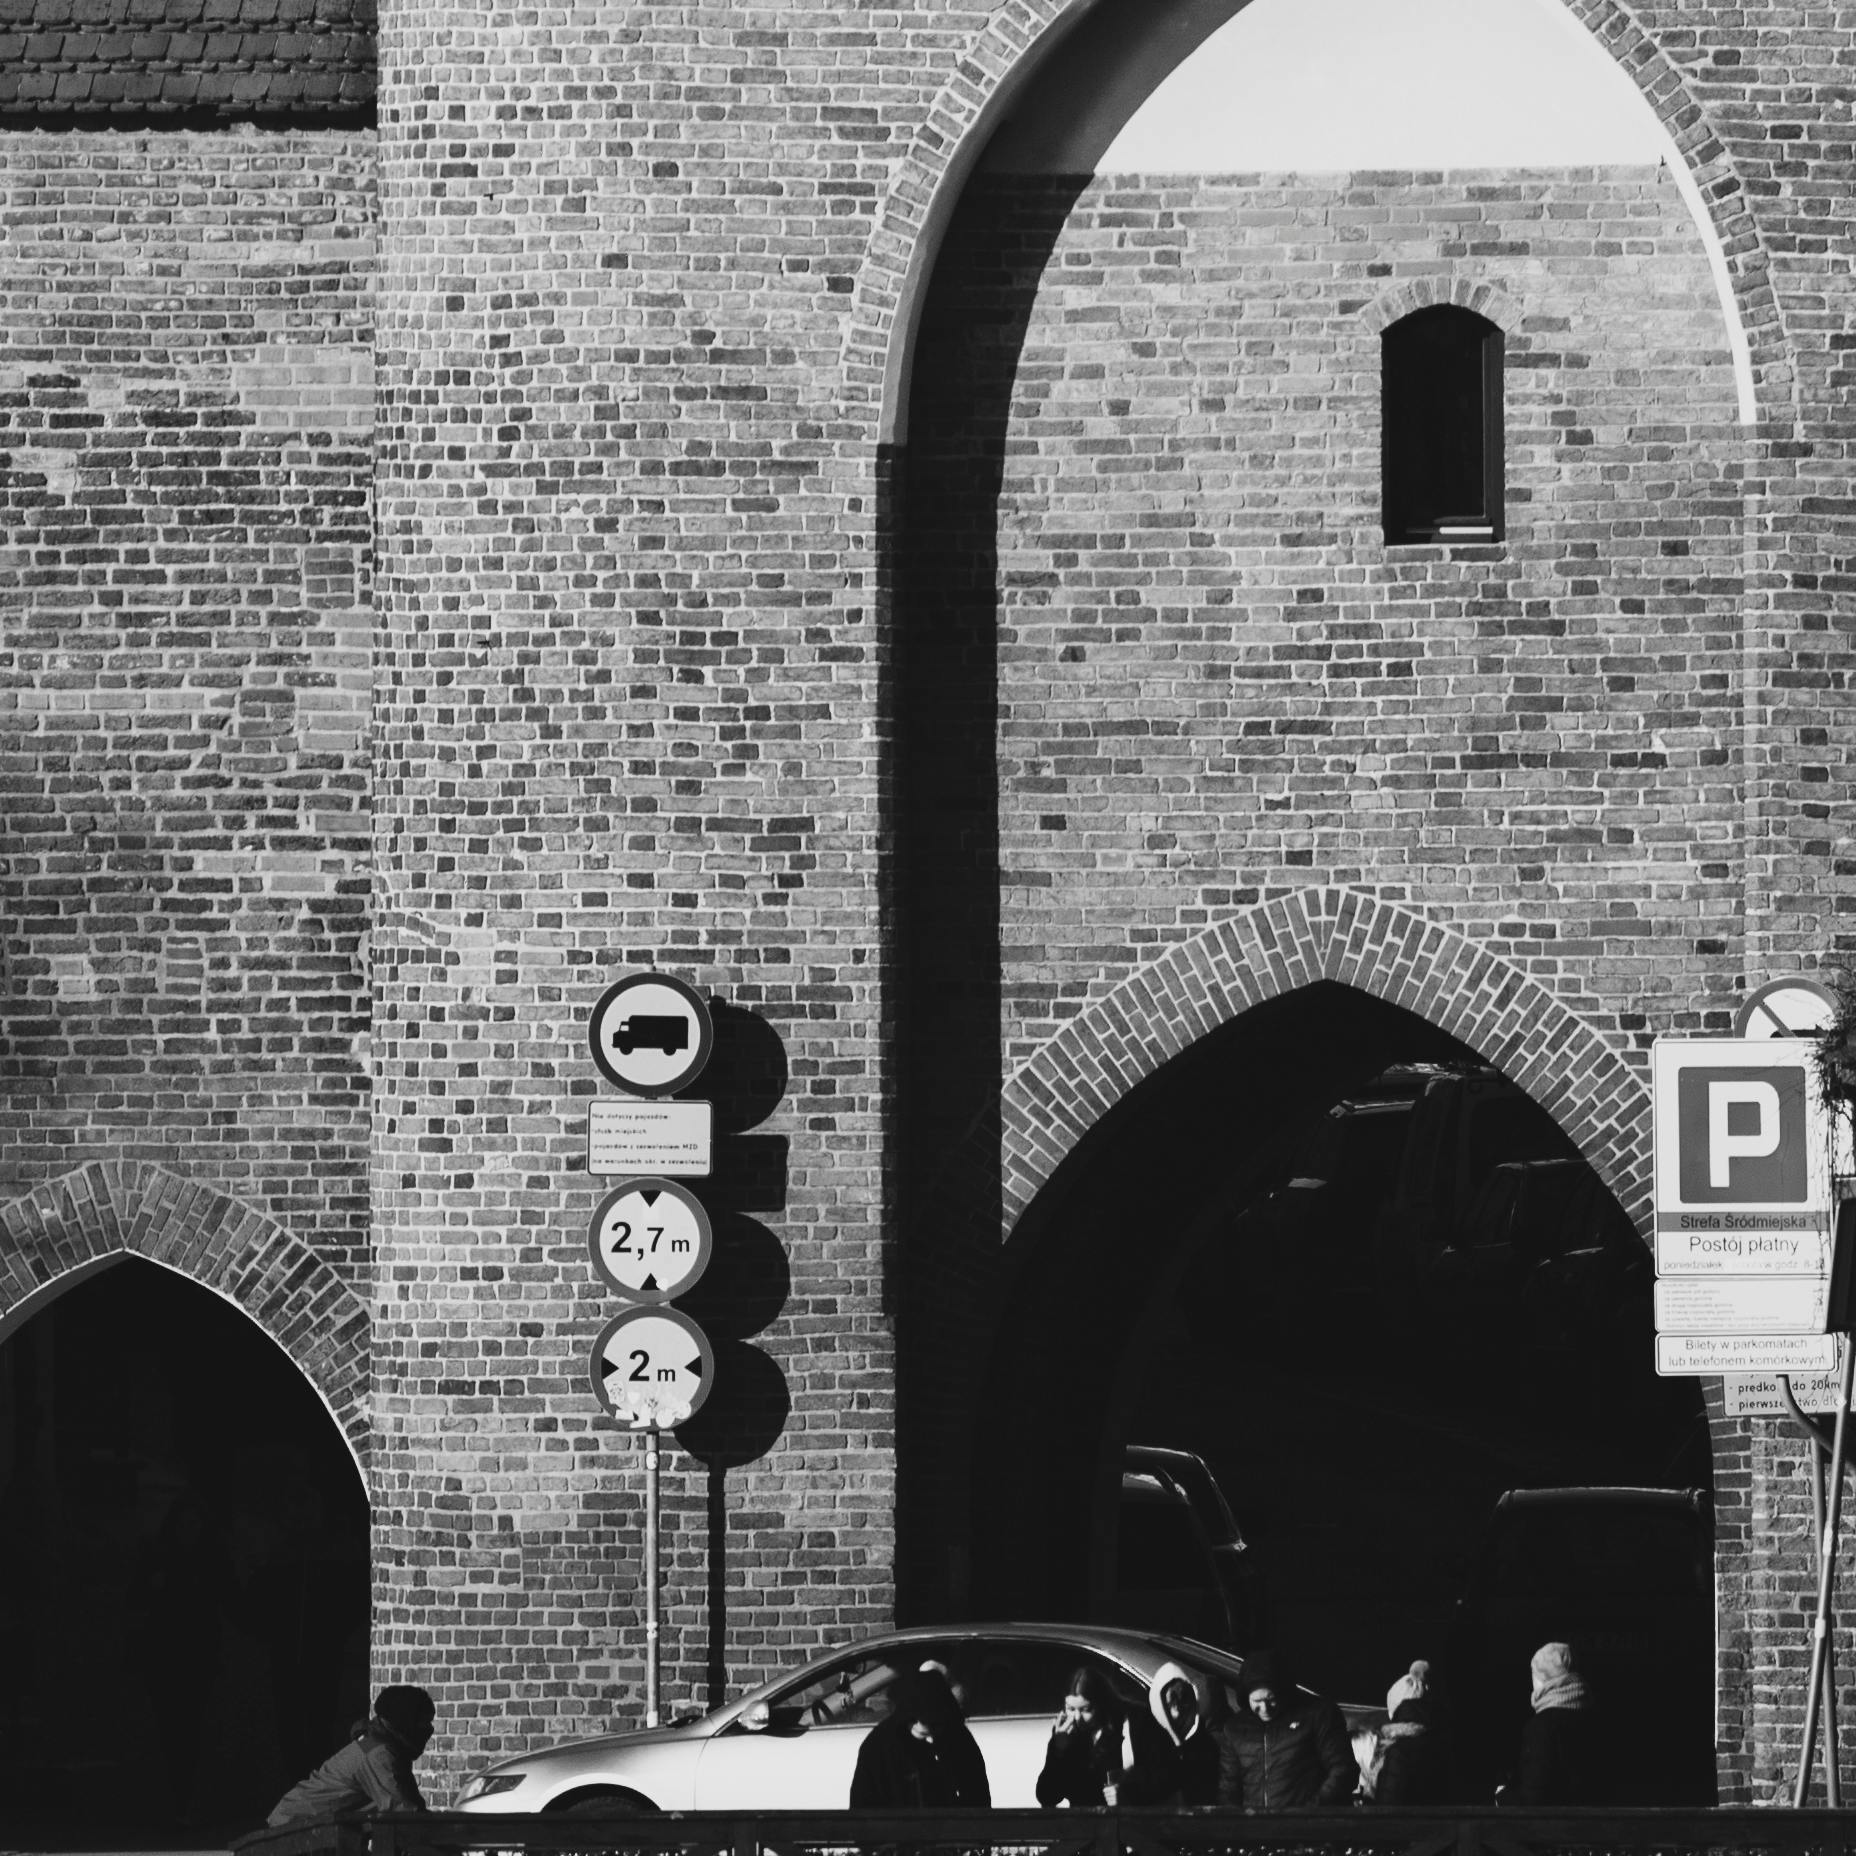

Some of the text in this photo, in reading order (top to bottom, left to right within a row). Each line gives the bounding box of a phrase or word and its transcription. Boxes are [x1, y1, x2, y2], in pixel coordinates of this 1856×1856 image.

[1709, 1081, 1780, 1187] P
[1680, 1212, 1807, 1230] Strefa Śródmiejska
[612, 1222, 689, 1260] 2,7 m
[1689, 1236, 1799, 1256] Postój płatny
[1685, 1339, 1717, 1353] Bilety
[1733, 1339, 1808, 1352] parkomatach
[629, 1350, 675, 1381] 2 m
[1668, 1355, 1825, 1368] lub telefonem komórkowym
[1792, 1381, 1806, 1391] do
